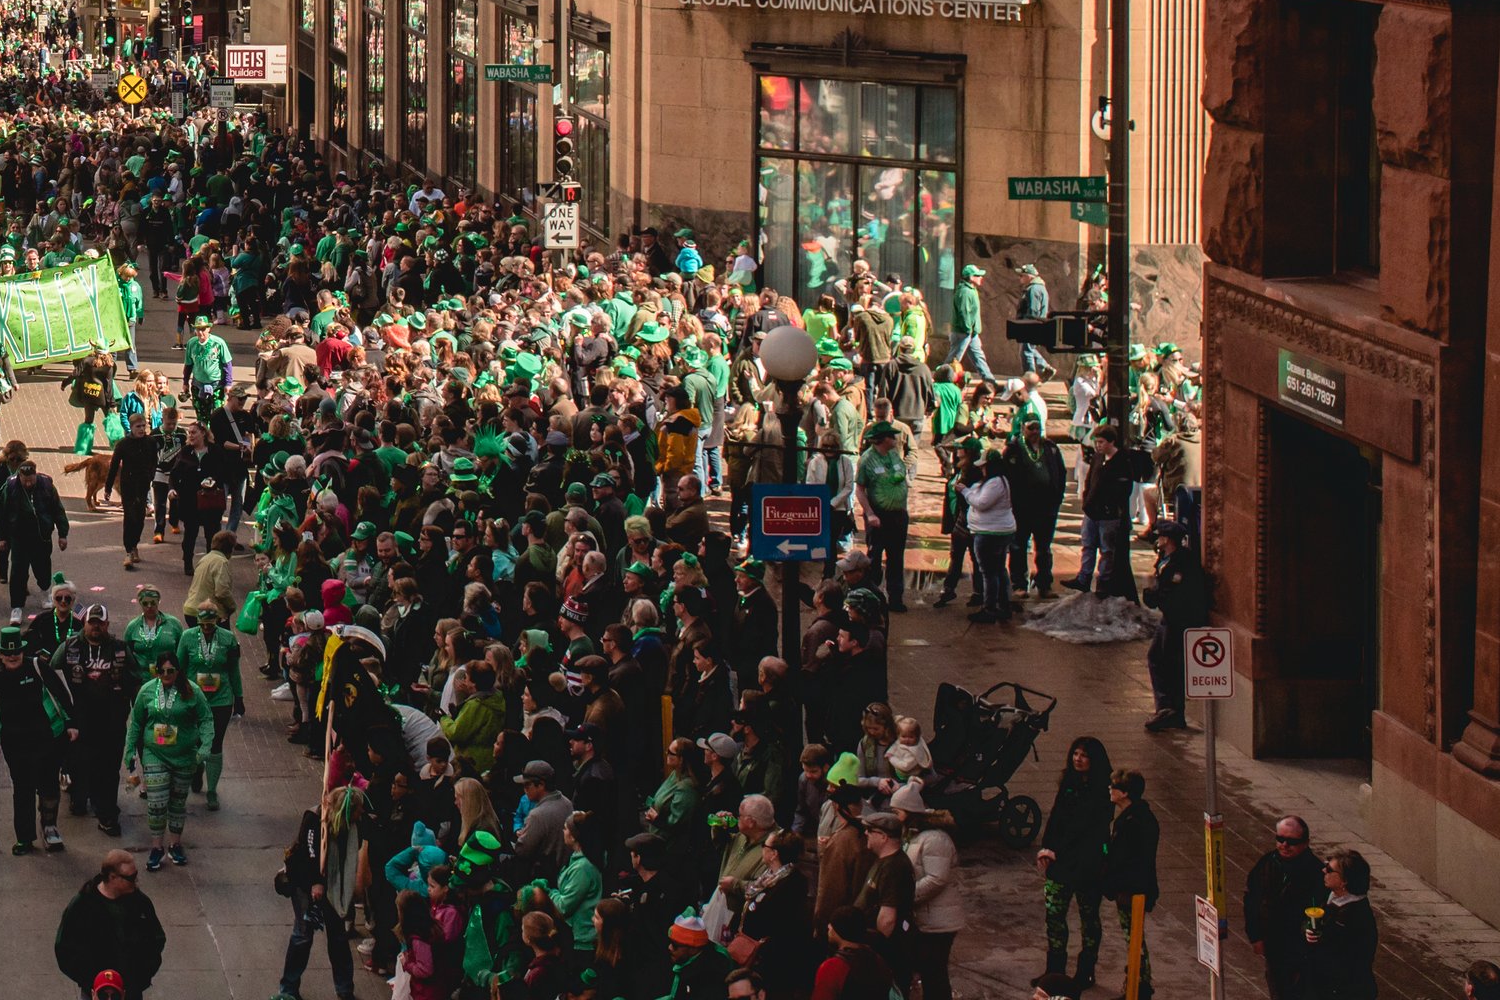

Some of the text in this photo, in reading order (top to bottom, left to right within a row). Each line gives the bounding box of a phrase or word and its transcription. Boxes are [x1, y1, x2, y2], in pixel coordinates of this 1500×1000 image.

[940, 1, 1021, 21] CENTER
[229, 52, 263, 67] WEIS
[229, 69, 263, 77] builders
[486, 67, 530, 78] WABASHA
[1015, 181, 1080, 195] WABASHA
[1083, 189, 1097, 197] 365
[550, 208, 574, 218] ONE
[550, 220, 574, 230] WAY
[765, 506, 819, 521] Fitzgerald
[1192, 676, 1228, 686] BEGINS
